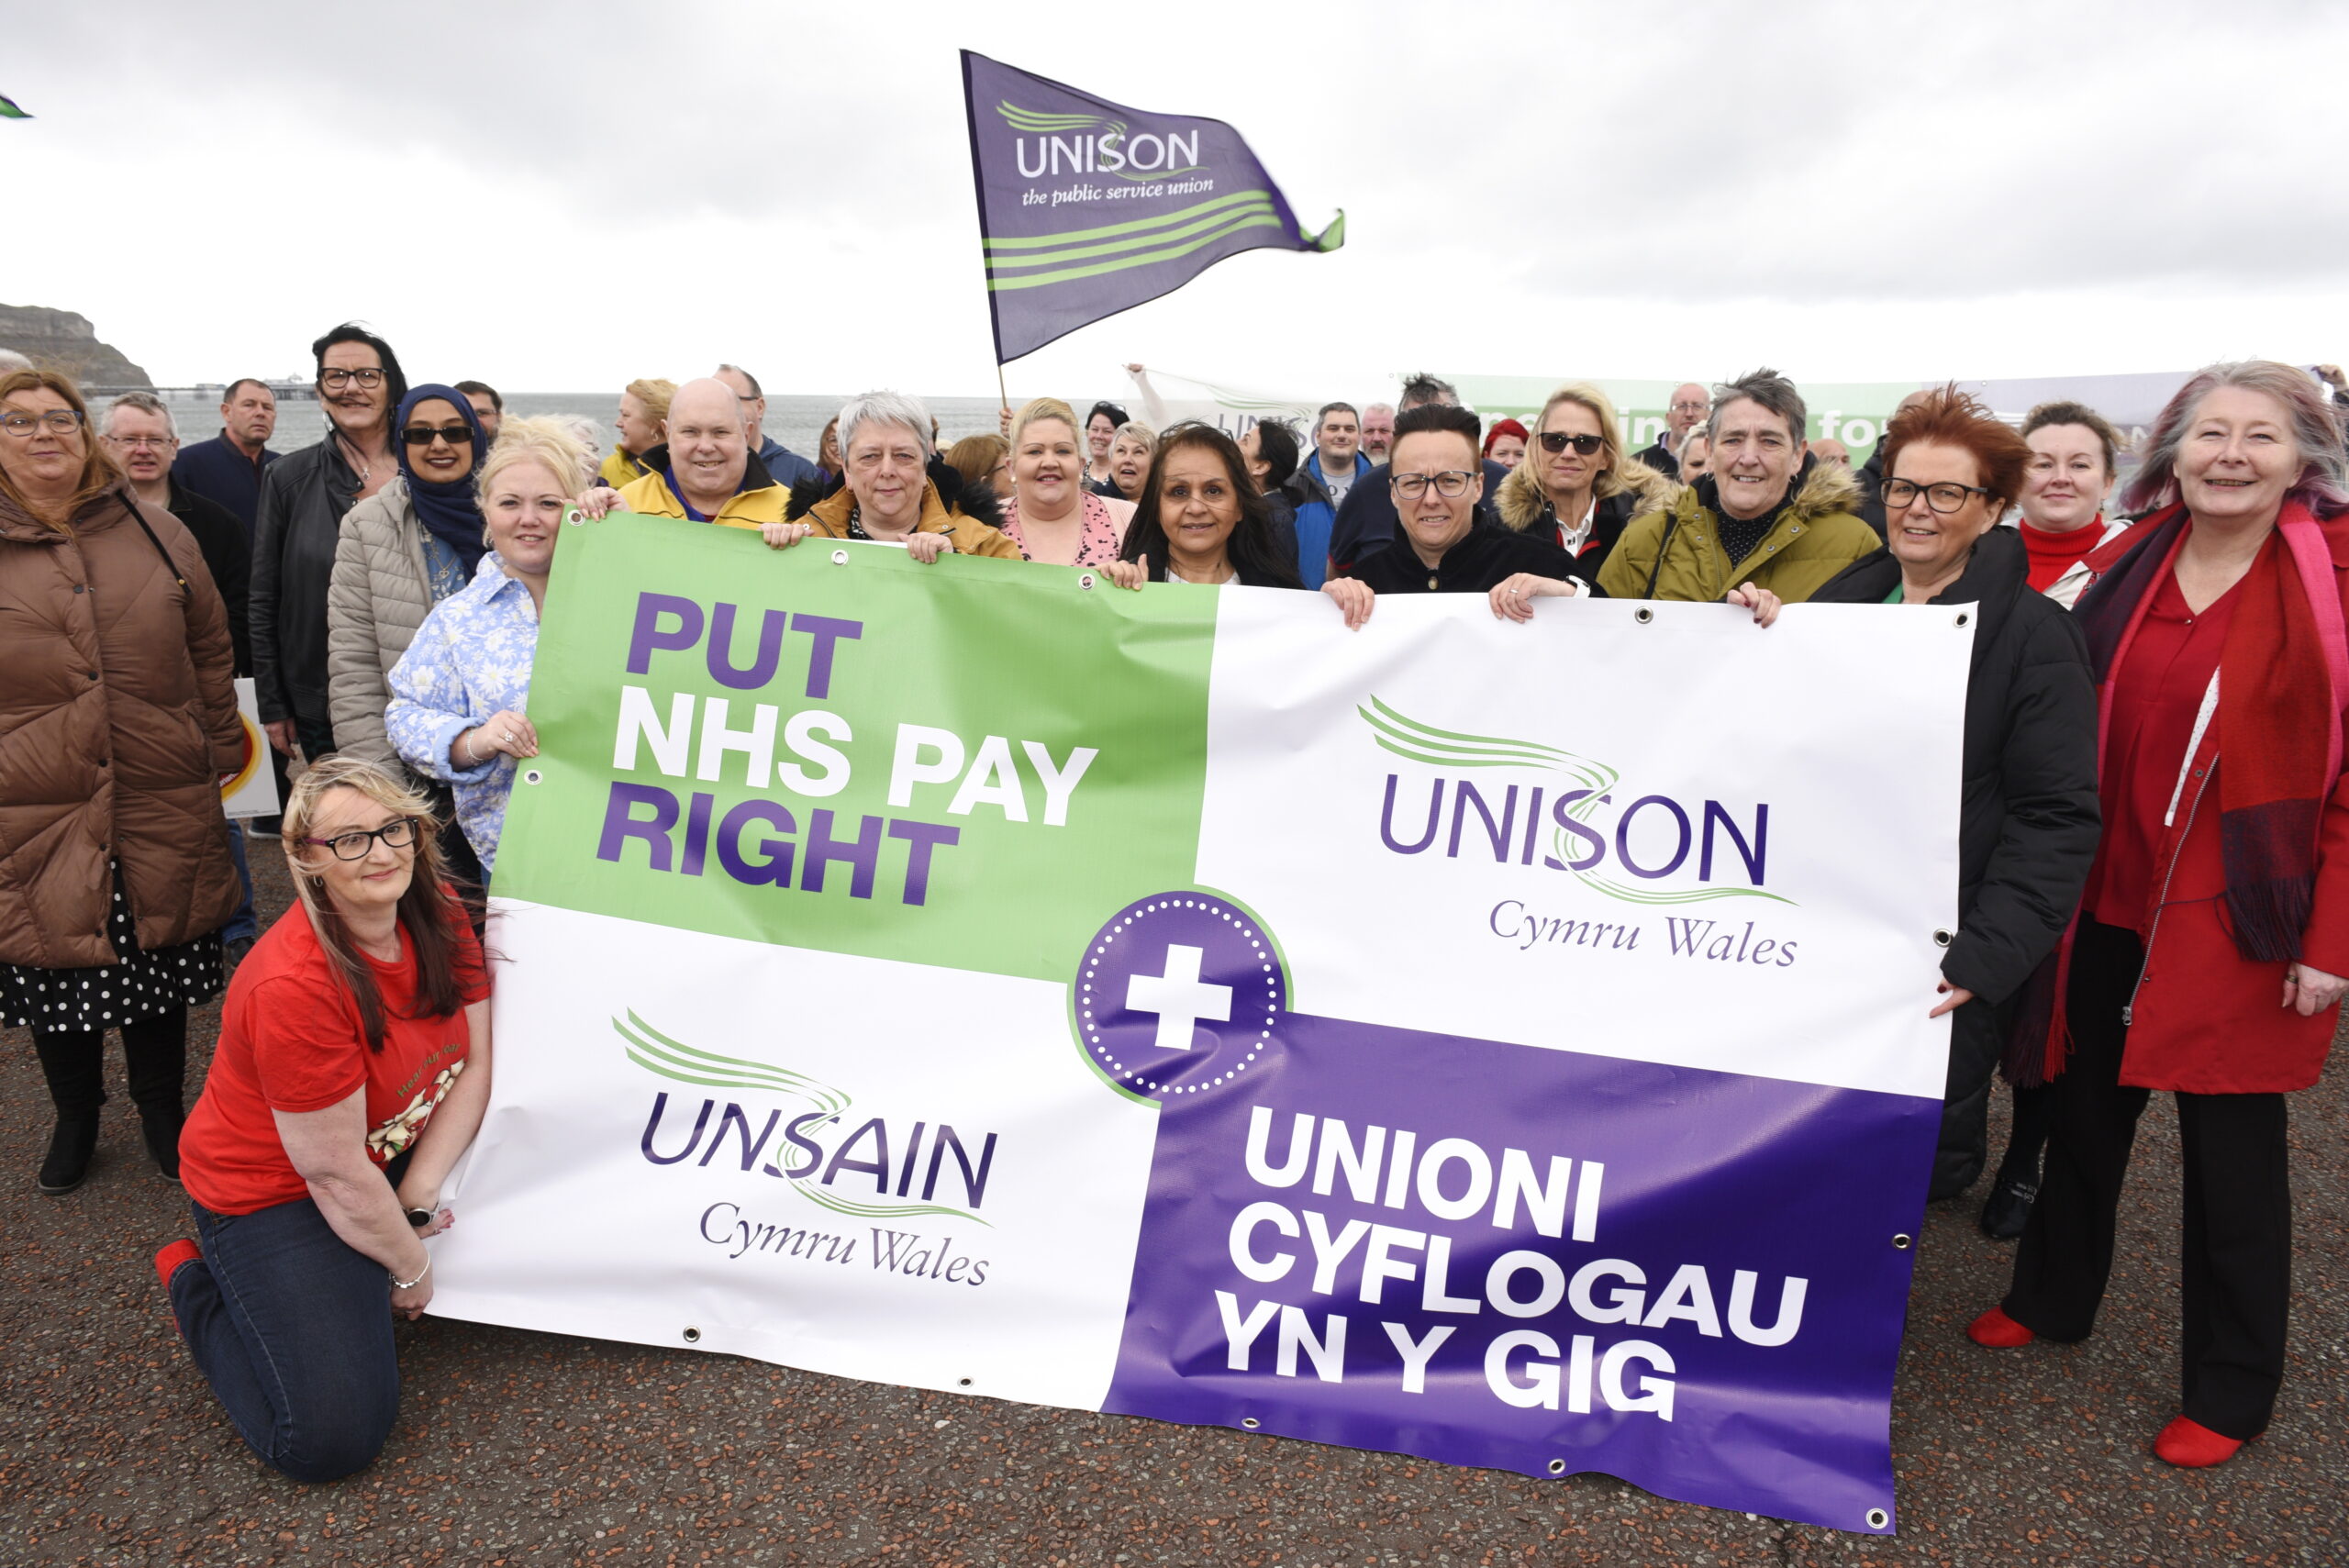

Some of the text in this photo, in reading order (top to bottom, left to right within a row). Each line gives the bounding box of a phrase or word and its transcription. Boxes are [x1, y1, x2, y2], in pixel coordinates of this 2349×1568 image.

[1016, 129, 1198, 178] UNISON
[1021, 177, 1214, 207] the public service union
[626, 592, 863, 699] PUT
[613, 684, 1099, 827] NHS PAY
[596, 781, 961, 906] RIGHT
[1380, 773, 1769, 886] UNISON
[1489, 900, 1798, 967] Cymru Wales
[640, 1092, 998, 1209] UNSAIN
[1245, 1106, 1605, 1242] UNIONI
[700, 1202, 990, 1286] Cymru Wales
[1229, 1201, 1809, 1347] CYFLOGAU
[1214, 1289, 1676, 1422] YN Y GIG
